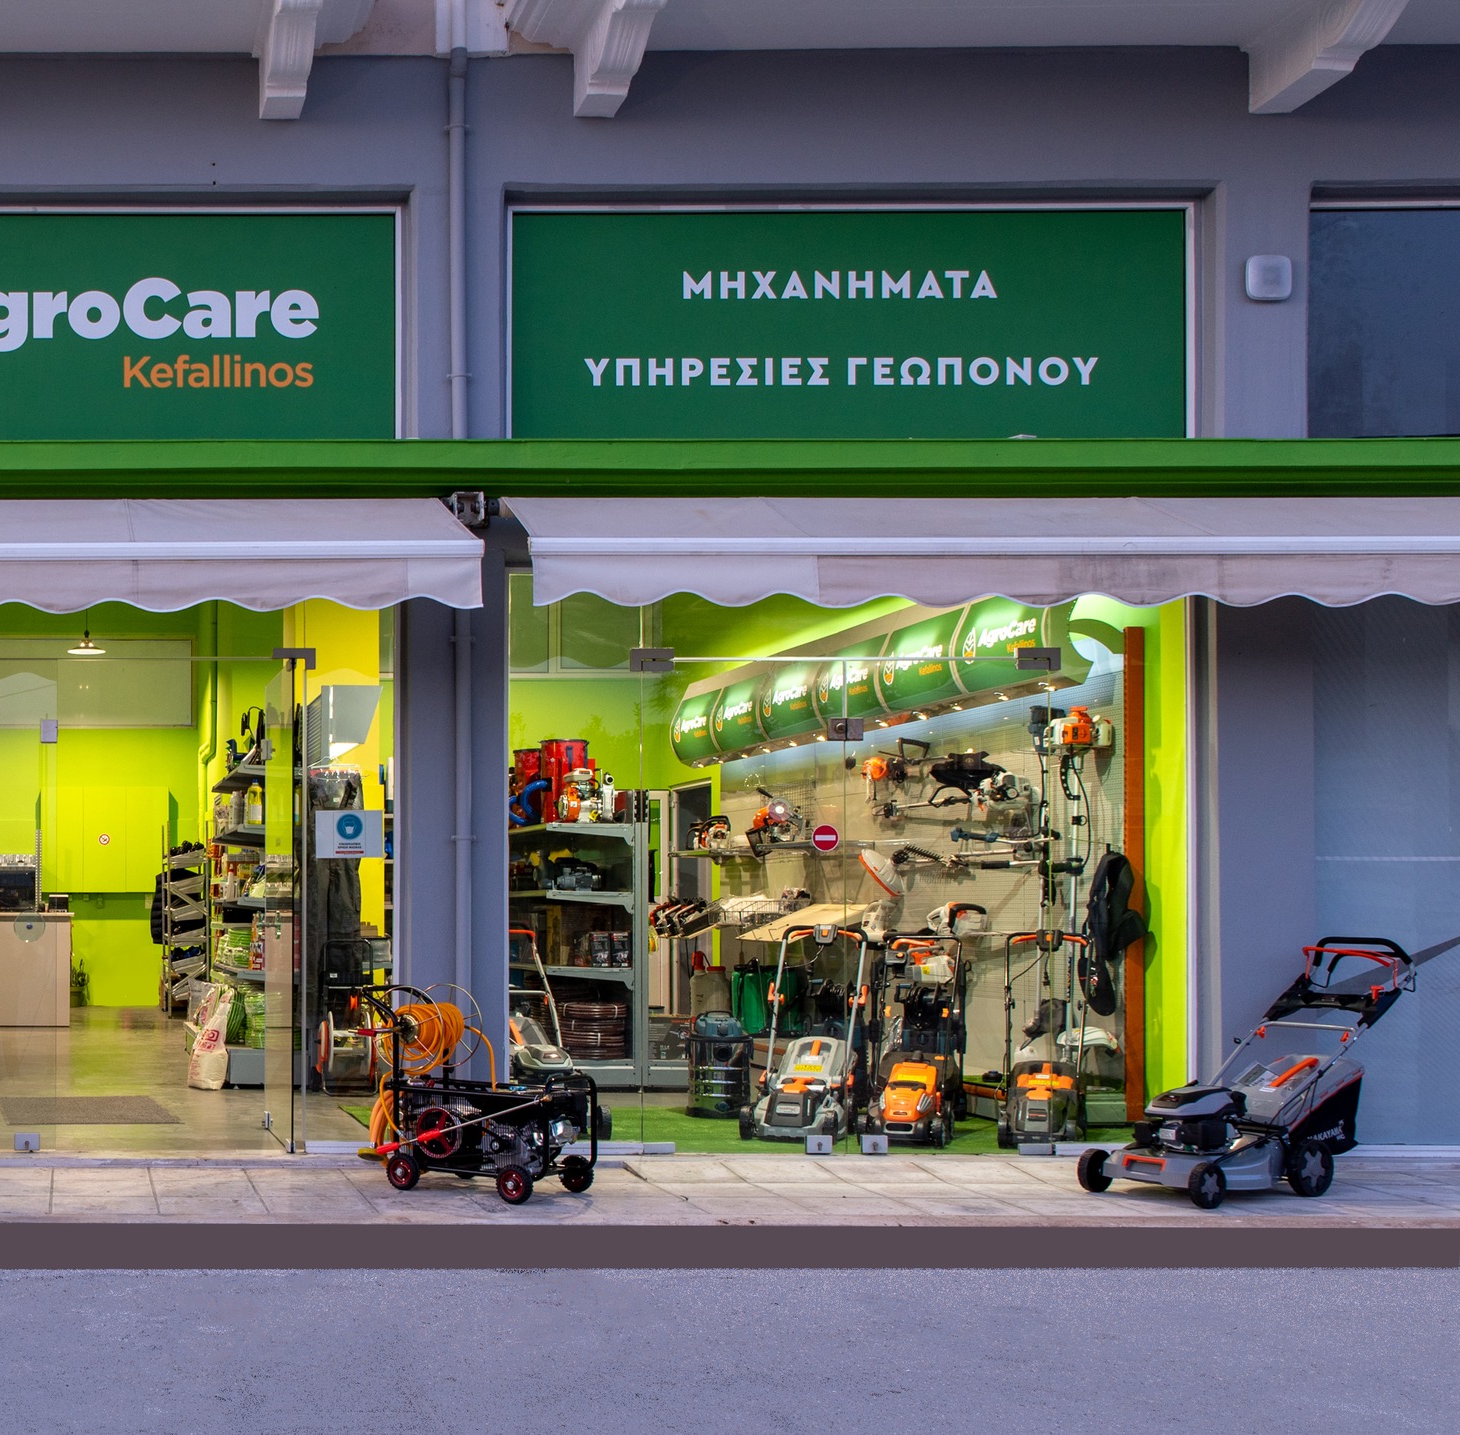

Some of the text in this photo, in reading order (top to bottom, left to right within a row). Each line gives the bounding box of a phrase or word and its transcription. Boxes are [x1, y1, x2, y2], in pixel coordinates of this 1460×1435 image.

[681, 270, 998, 300] ΜΗΧΑΝΗΜΑΤΑ
[123, 355, 315, 389] Kefallinos
[583, 356, 1099, 387] ΥΠΗΡΕΣΙΕΣ ΓΕΩΠΟΝΟΥ
[977, 618, 1037, 648] AgroCare
